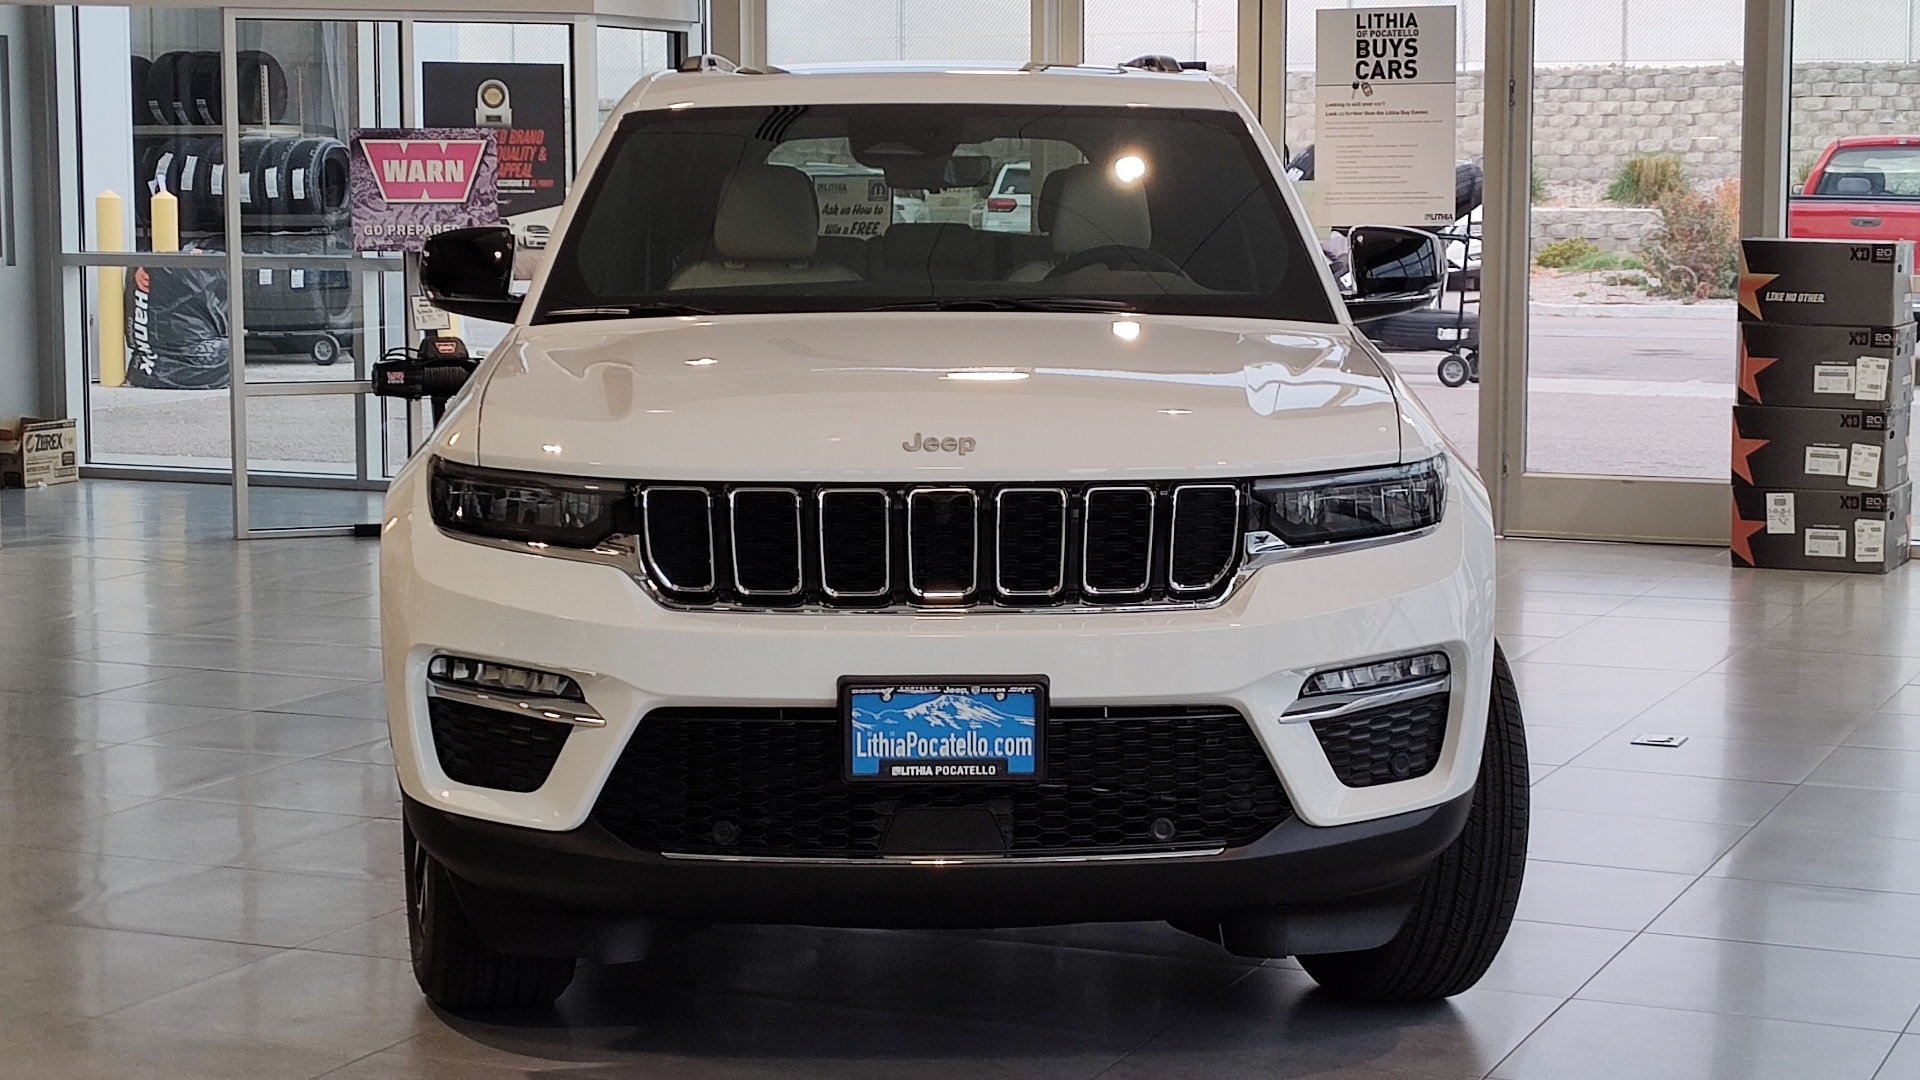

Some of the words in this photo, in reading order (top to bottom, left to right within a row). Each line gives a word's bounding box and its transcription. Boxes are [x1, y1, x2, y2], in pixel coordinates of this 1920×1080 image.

[1356, 12, 1418, 29] LITHIA
[1356, 30, 1368, 38] OF
[1369, 29, 1419, 37] POCATELLO
[1356, 38, 1418, 58] BUYS
[1355, 59, 1418, 79] CARS
[509, 129, 545, 145] BRAND
[538, 146, 548, 162] &
[382, 159, 465, 183] WARN
[822, 203, 839, 215] Ask
[840, 206, 850, 215] us
[852, 203, 872, 215] How
[874, 204, 884, 215] to
[363, 224, 383, 236] GO
[824, 223, 841, 235] Win
[850, 221, 880, 235] FREE
[1850, 247, 1870, 261] XD
[1876, 248, 1893, 257] 20
[1765, 291, 1785, 302] LIKE
[1785, 292, 1797, 302] NO
[1848, 332, 1869, 346] XD
[1874, 333, 1892, 342] 20
[1840, 414, 1860, 428] XD
[1866, 415, 1882, 424] 20
[902, 432, 976, 456] Jeep
[1840, 496, 1859, 510] XD
[1865, 497, 1882, 506] 20
[856, 731, 1032, 757] LithiaPocatello.com
[901, 765, 933, 776] LITHIA
[935, 765, 996, 776] POCATELLO
